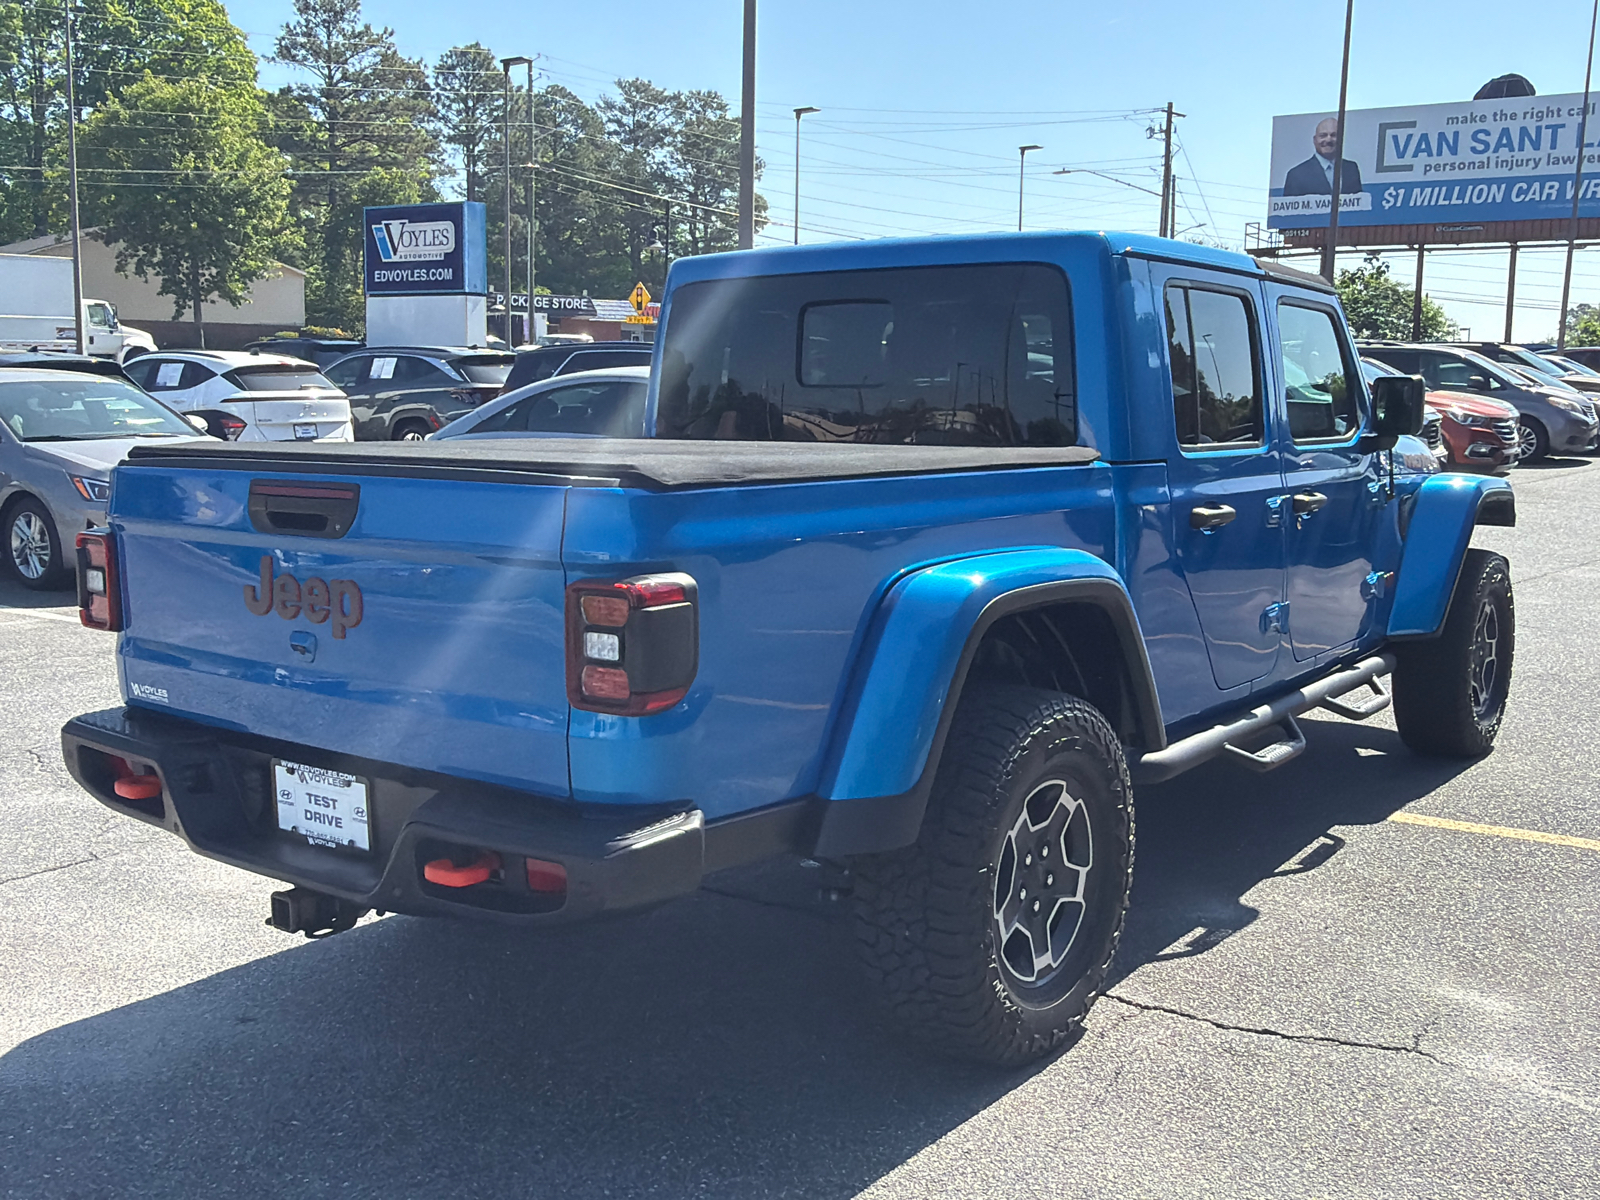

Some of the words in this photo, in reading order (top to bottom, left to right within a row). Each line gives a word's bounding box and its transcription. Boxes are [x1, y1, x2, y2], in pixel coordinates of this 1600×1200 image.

[1446, 112, 1487, 125] make
[1492, 110, 1518, 122] the
[1522, 106, 1563, 122] right
[1391, 130, 1460, 159] VAN
[1470, 123, 1566, 155] SANT
[1423, 157, 1490, 175] personal
[1495, 154, 1542, 171] injury
[1381, 186, 1406, 210] $1
[1409, 183, 1506, 207] MILLION
[1510, 181, 1560, 203] CAR
[1273, 201, 1300, 212] DAVID
[1301, 201, 1313, 210] M.
[374, 268, 453, 282] EDVOYLES.COM
[496, 294, 549, 308] PCKGE
[552, 298, 588, 310] STORE
[243, 555, 363, 639] Jeep
[140, 684, 168, 697] VOYLES
[308, 773, 345, 788] VOYLES
[305, 792, 338, 810] TEST
[304, 809, 343, 828] DRIVE
